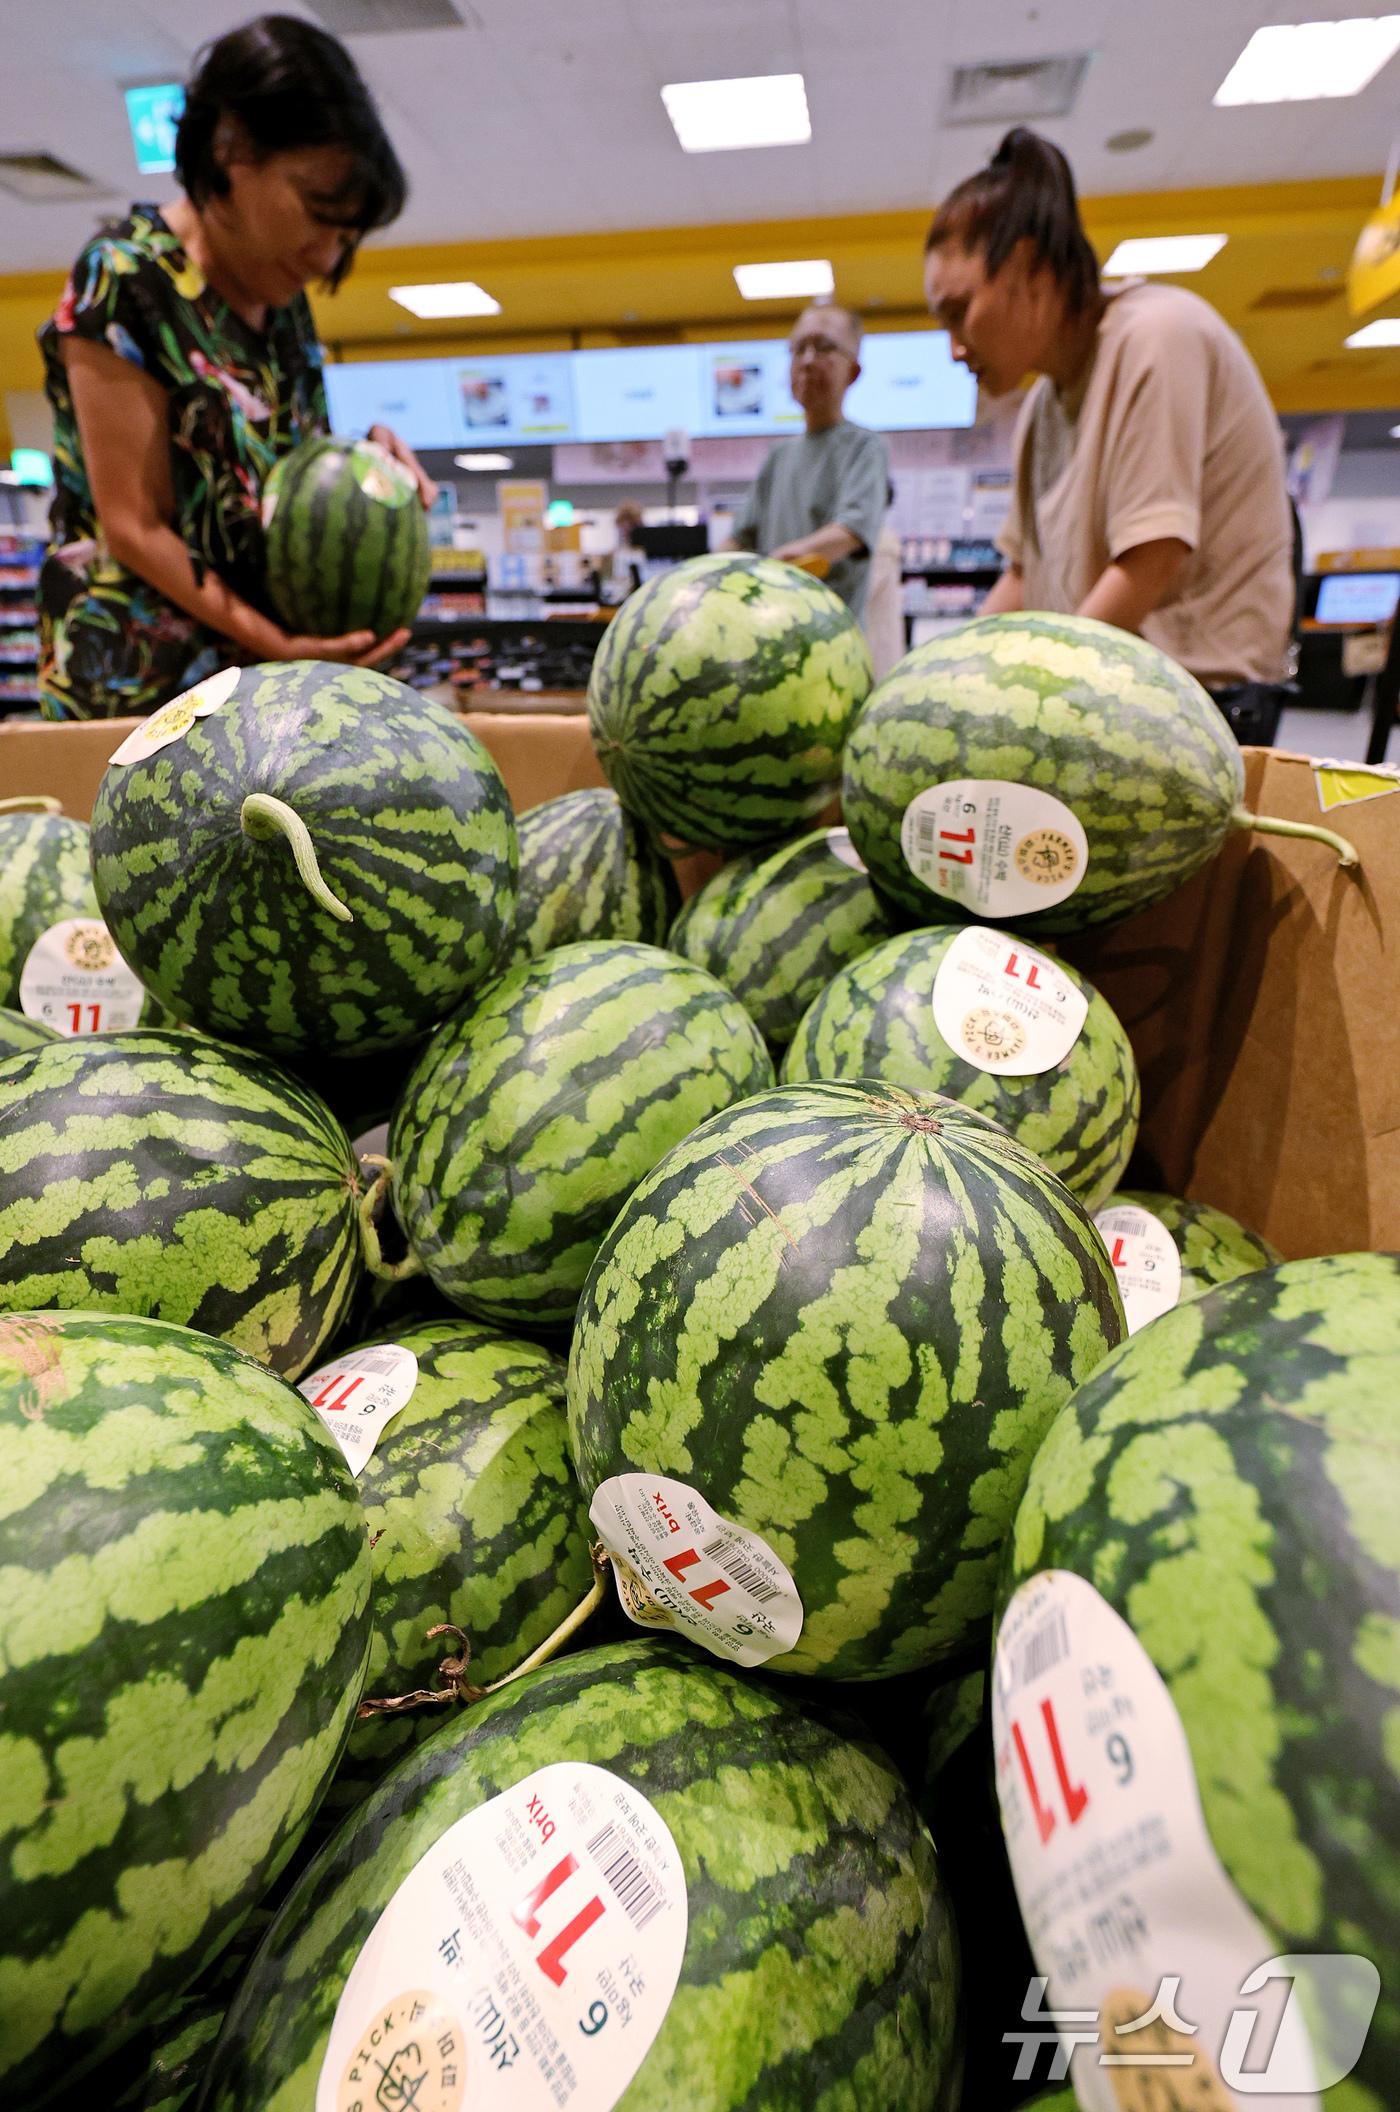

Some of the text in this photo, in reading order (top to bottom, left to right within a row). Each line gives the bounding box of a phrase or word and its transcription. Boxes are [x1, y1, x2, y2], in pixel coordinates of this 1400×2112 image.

[963, 803, 976, 814] 6
[939, 828, 975, 864] 11
[1005, 953, 1041, 989] 11
[1057, 991, 1066, 1002] 6
[67, 1003, 101, 1033] 11
[1144, 1260, 1156, 1272] 6
[312, 1375, 365, 1411] 11
[358, 1404, 376, 1416] 6
[715, 1523, 734, 1538] 보관
[732, 1534, 755, 1553] 곳에
[652, 1492, 754, 1635] 6 11 brix
[752, 1611, 775, 1632] 국산
[1010, 1696, 1090, 1849] 11
[1106, 1733, 1136, 1787] 6
[612, 1790, 632, 1816] 보관
[615, 1820, 639, 1855] 048761
[627, 1811, 647, 1839] 곳에
[640, 1859, 666, 1897] 500000
[510, 1793, 609, 2036] 6 11 brix
[616, 1950, 649, 1999] 국산
[348, 2012, 394, 2082] PICK
[409, 2000, 457, 2088] 파머픽
